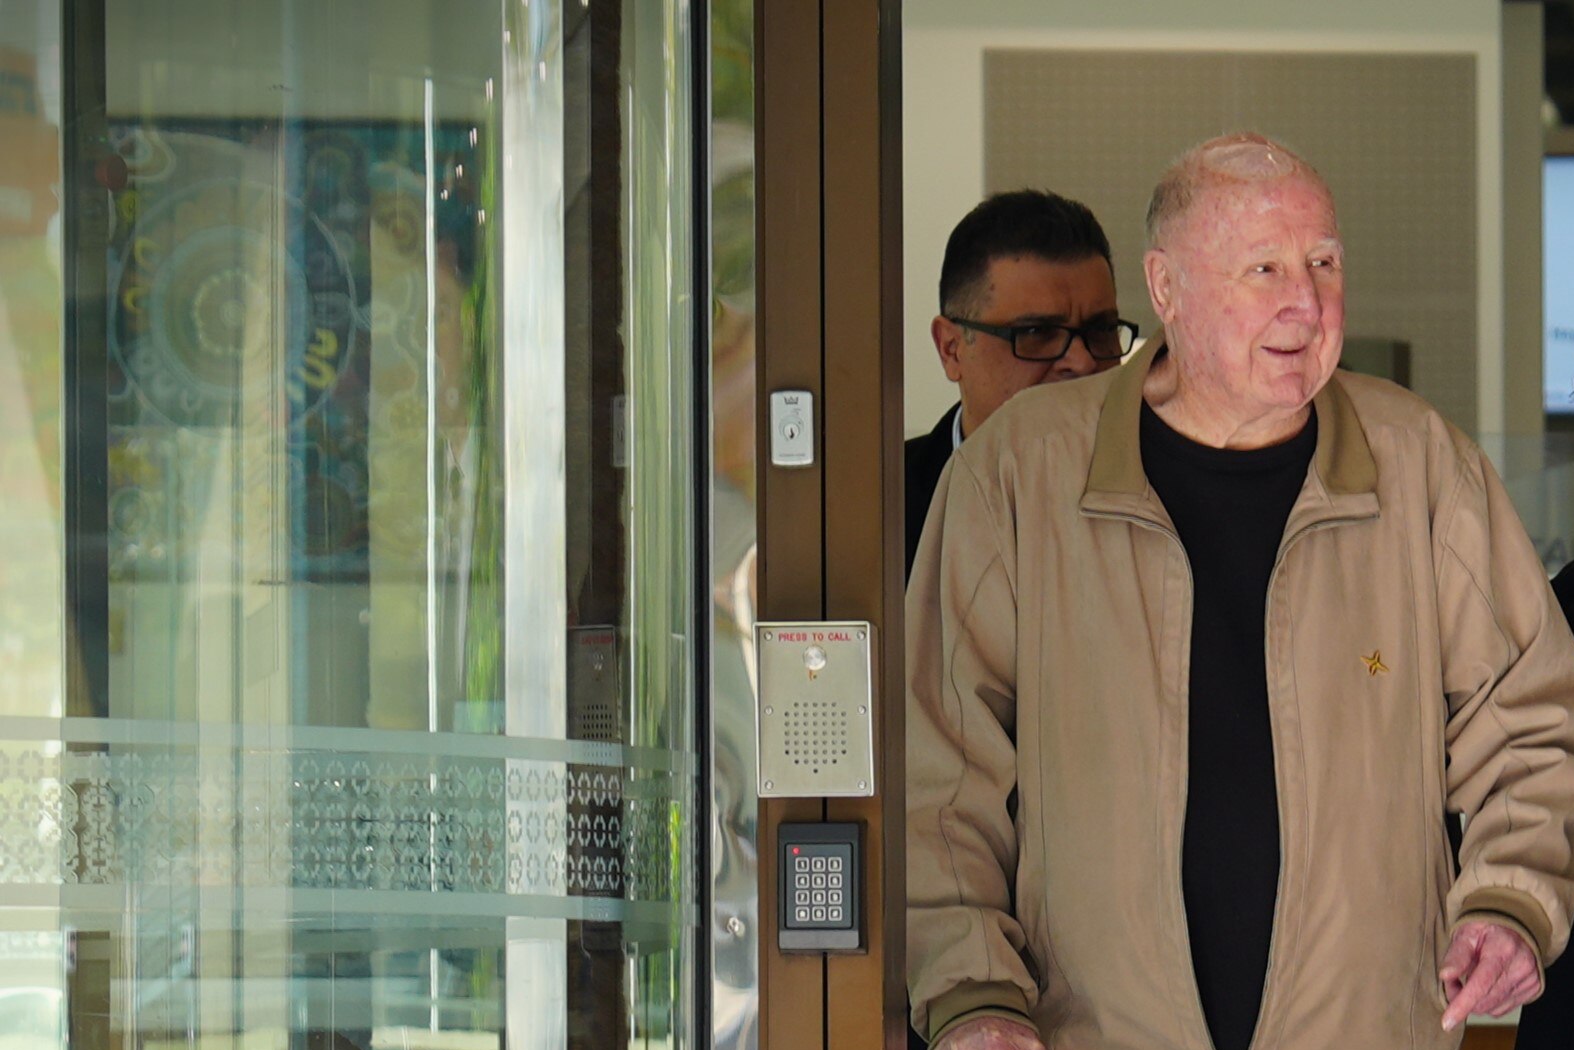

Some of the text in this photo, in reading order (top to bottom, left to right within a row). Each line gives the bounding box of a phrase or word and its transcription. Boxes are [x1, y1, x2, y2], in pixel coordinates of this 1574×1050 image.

[778, 632, 851, 642] PRESS TO CALL
